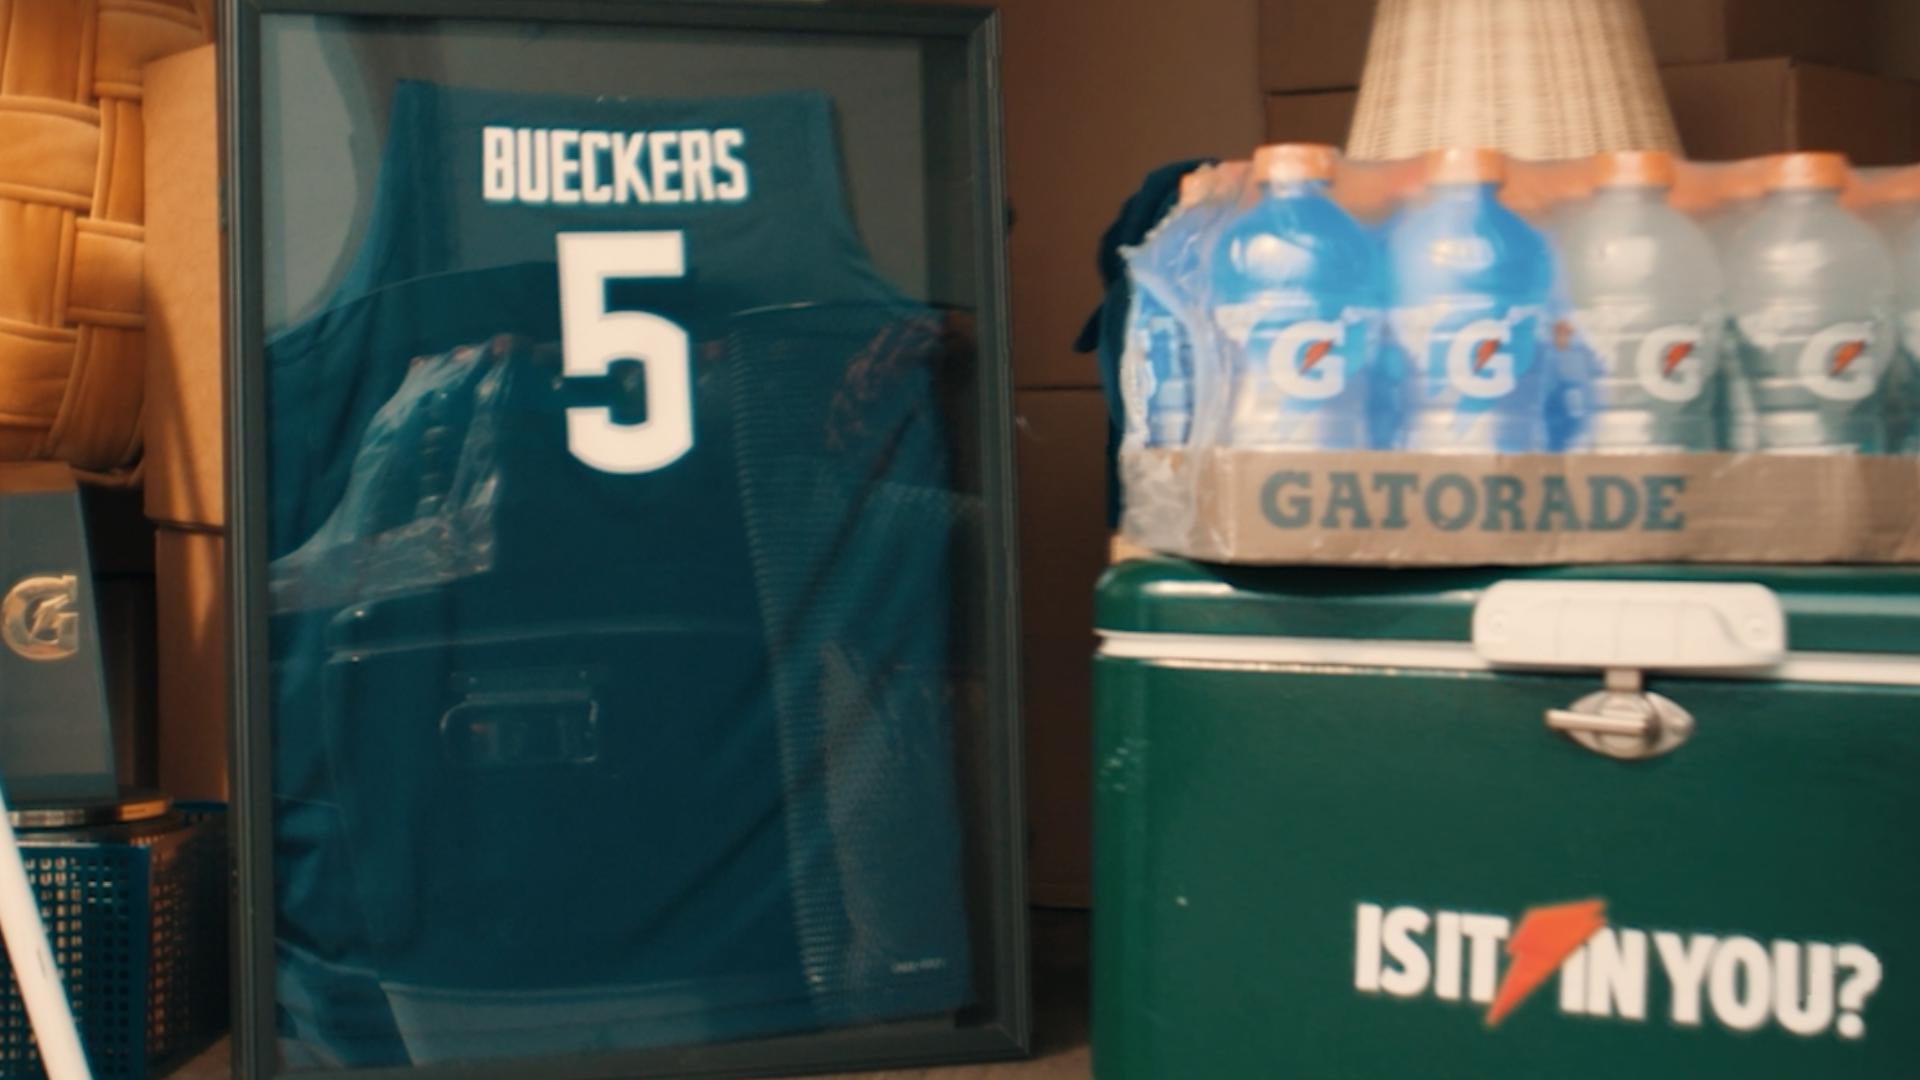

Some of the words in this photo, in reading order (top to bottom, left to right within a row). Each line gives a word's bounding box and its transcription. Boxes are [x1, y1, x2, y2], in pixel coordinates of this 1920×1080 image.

[482, 126, 749, 204] BUECKERS
[556, 230, 694, 475] 5
[1268, 322, 1345, 400] G
[1445, 322, 1516, 398] G
[1636, 326, 1701, 401] G
[1800, 322, 1880, 400] G
[1259, 470, 1687, 533] GATORADE
[1355, 903, 1431, 997] IS
[1434, 911, 1511, 1004] IT
[1560, 926, 1647, 1021] IN
[1652, 930, 1884, 1039] YOU?
